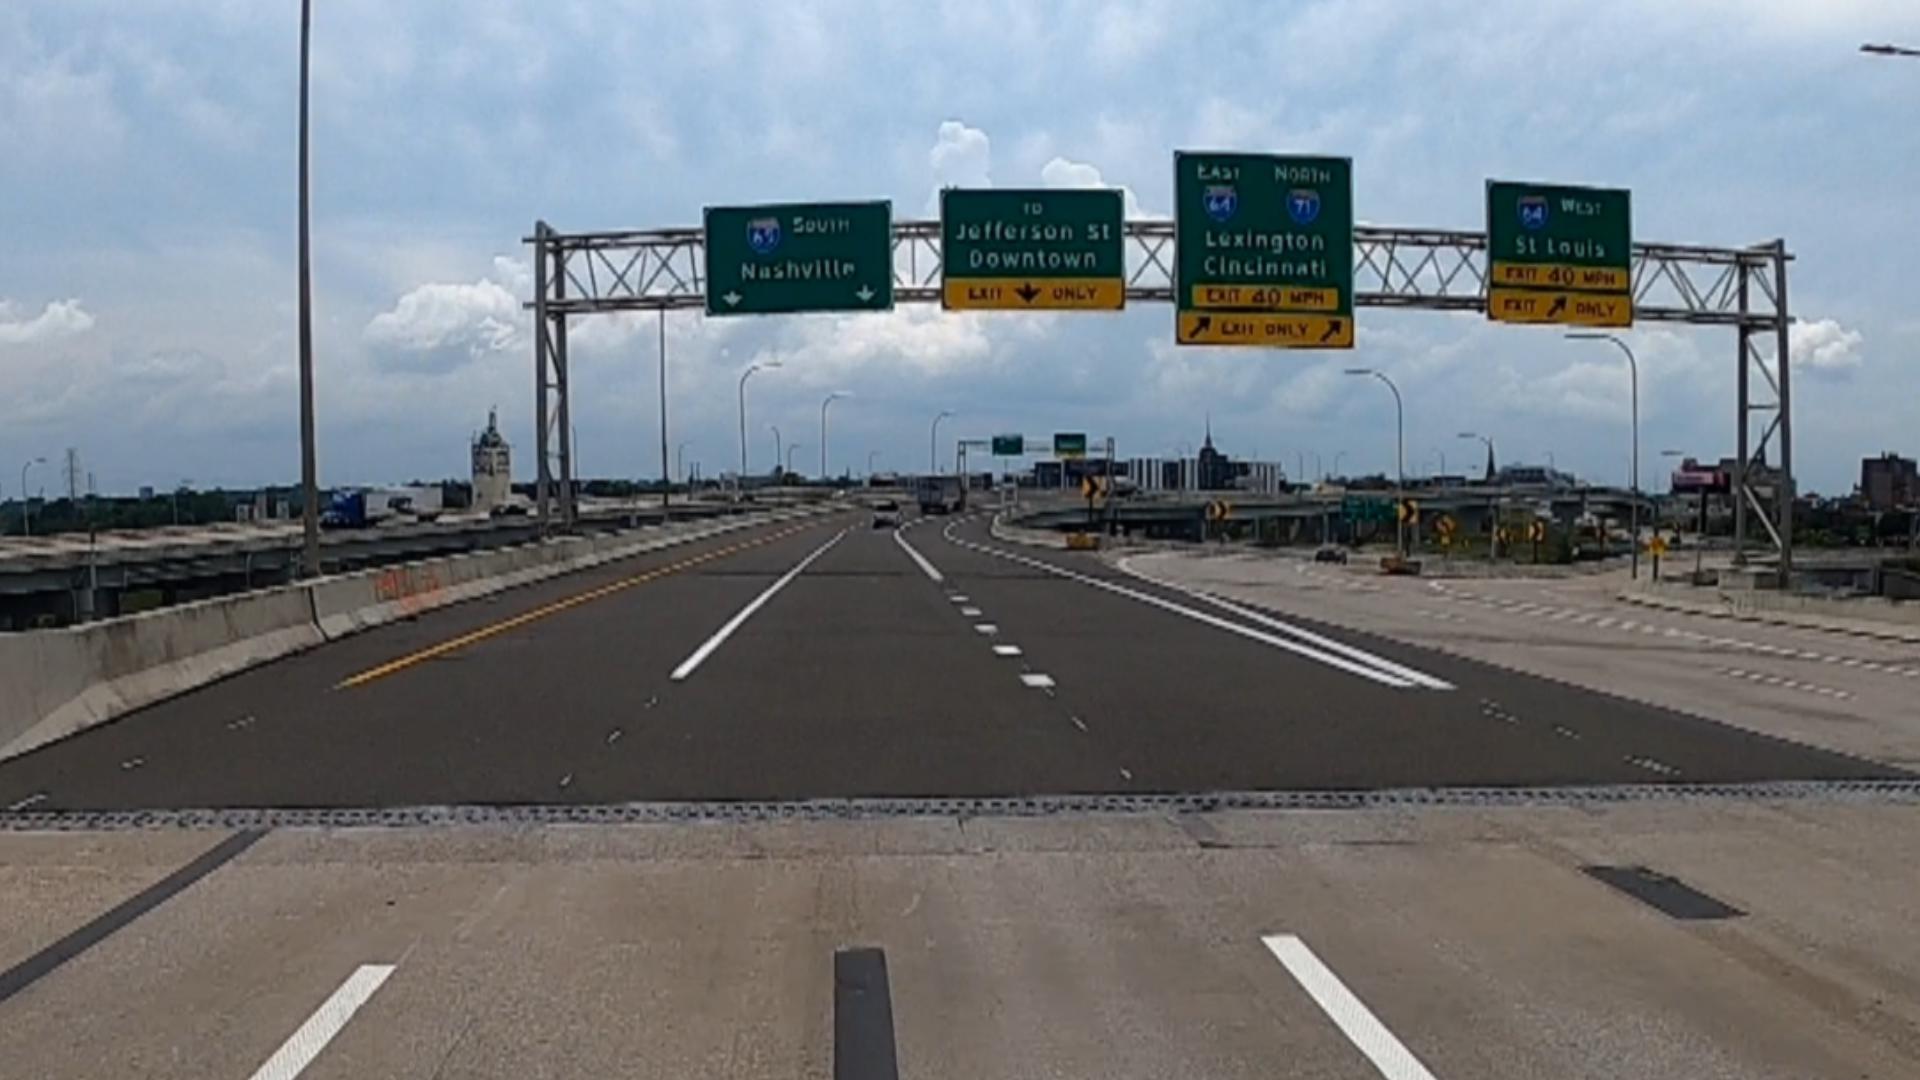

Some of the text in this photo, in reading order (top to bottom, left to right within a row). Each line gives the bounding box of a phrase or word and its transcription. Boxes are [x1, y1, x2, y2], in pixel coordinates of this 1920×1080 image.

[1197, 164, 1331, 183] EAST NORTH
[956, 221, 1111, 241] Jefferson St
[1205, 228, 1325, 253] Lexington
[1516, 235, 1605, 258] St Louis
[969, 250, 1097, 269] Downtown
[1204, 256, 1327, 279] Cincinnati
[741, 259, 855, 281] Nashville
[1506, 266, 1616, 286] EXIT 40 MPH
[1052, 287, 1098, 300] ONLY
[1206, 288, 1325, 305] EXIT 40 MPH
[1504, 299, 1617, 318] EXIT ONLY
[1221, 322, 1309, 337] EXIT ONLY
